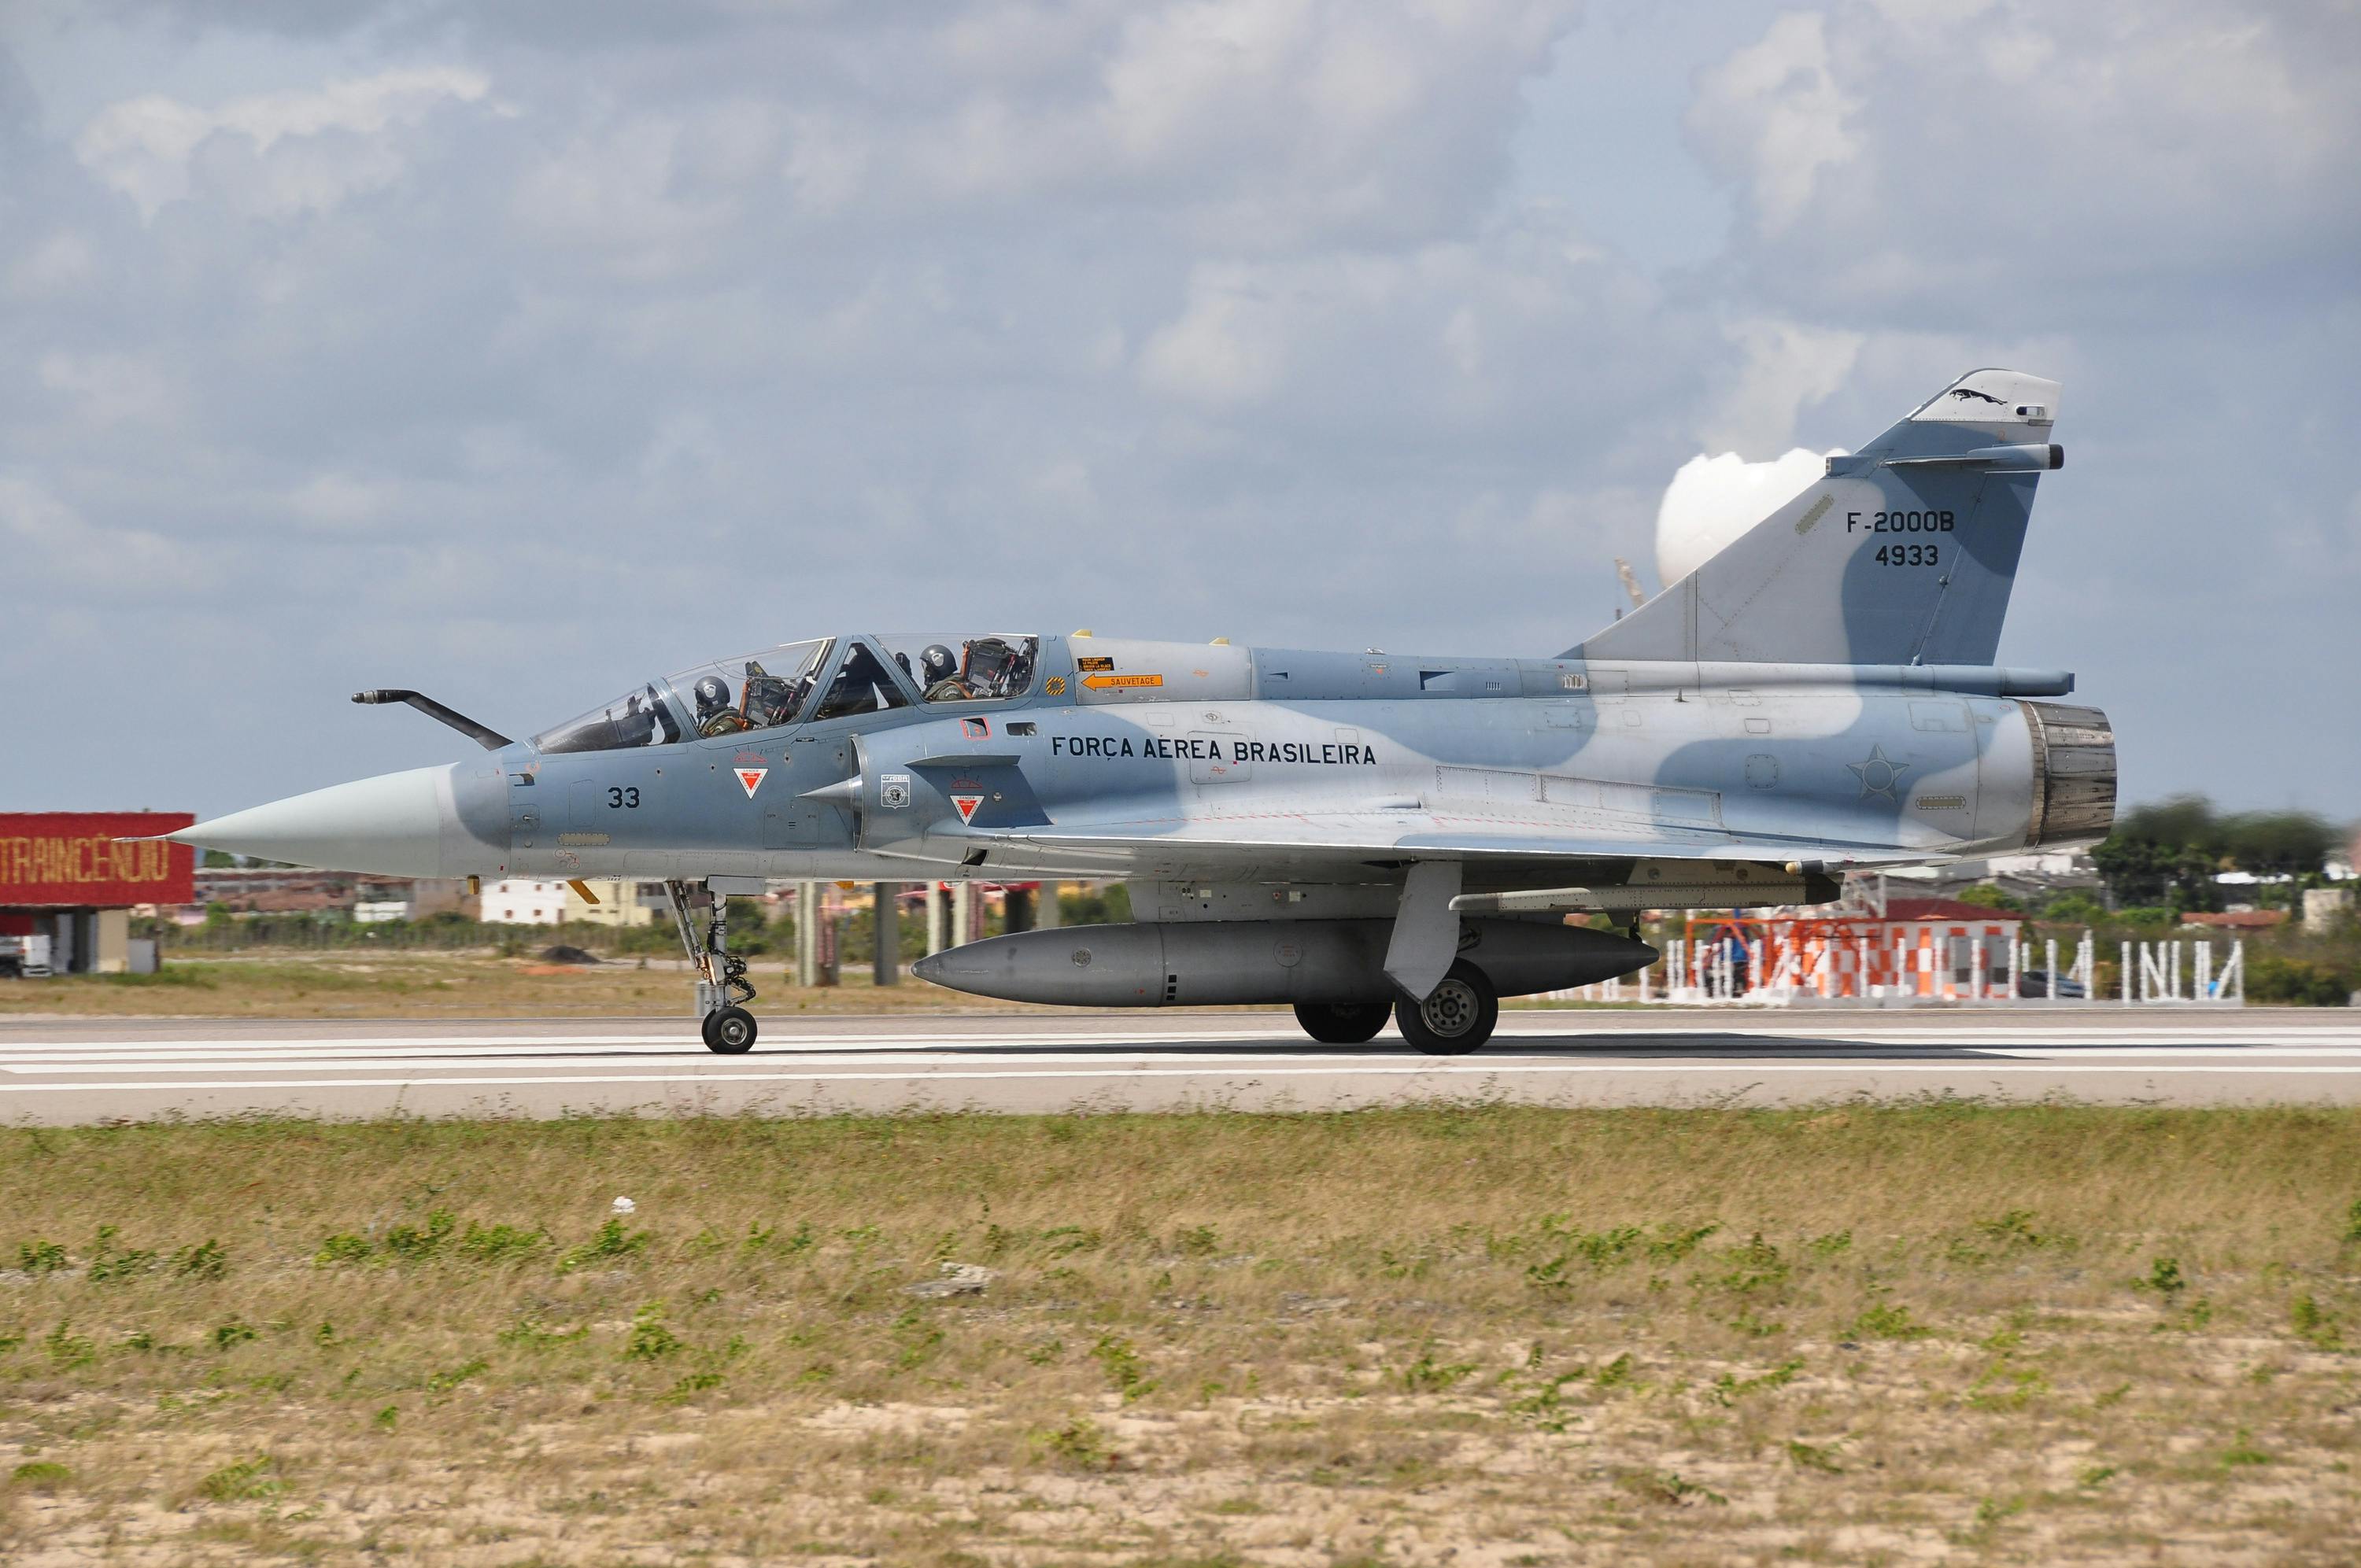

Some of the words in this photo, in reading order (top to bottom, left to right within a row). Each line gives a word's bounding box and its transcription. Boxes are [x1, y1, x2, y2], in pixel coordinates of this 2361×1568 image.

[1847, 511, 1955, 533] F-2000B
[1875, 544, 1939, 566] 4933
[1051, 736, 1134, 762] FORÇA
[1233, 741, 1377, 765] BRASILEIRA
[608, 787, 640, 809] 33
